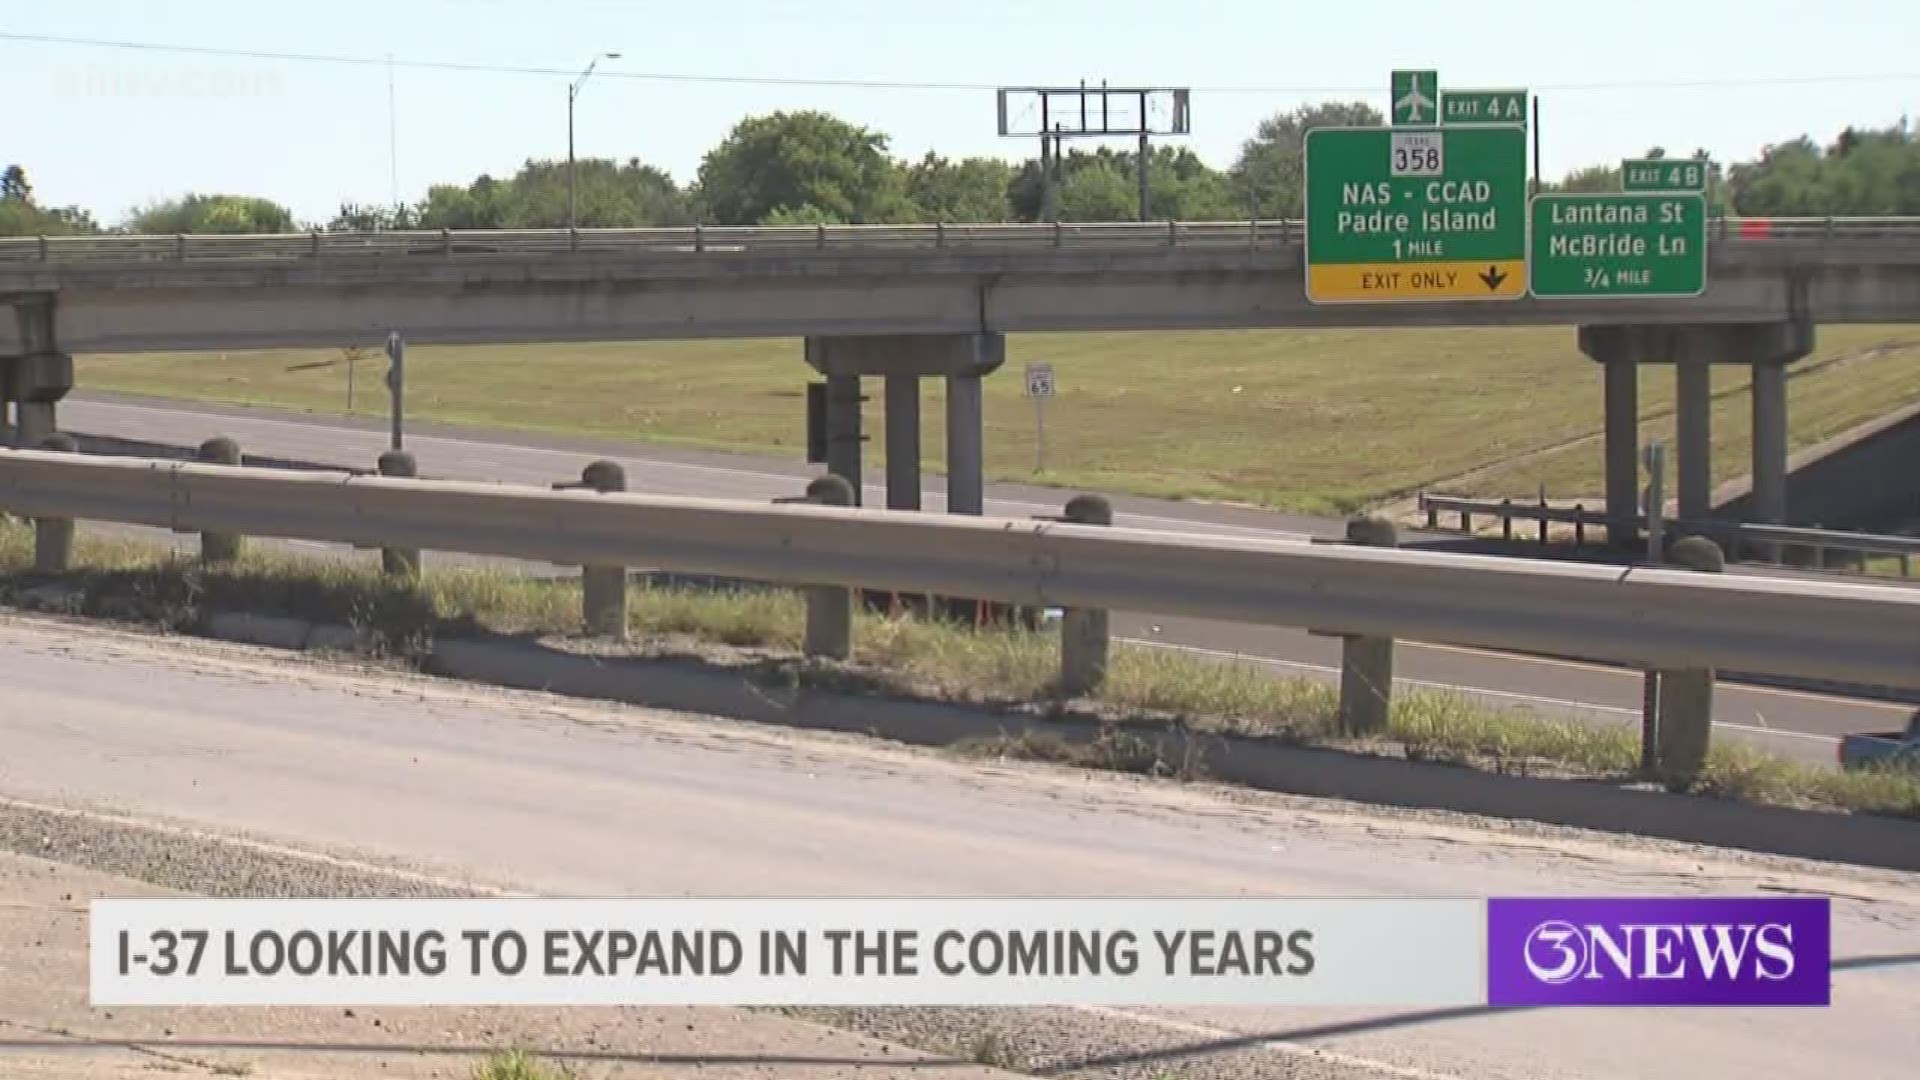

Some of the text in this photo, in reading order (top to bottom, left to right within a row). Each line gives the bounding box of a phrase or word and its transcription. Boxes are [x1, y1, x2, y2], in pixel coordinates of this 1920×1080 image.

[1448, 97, 1479, 115] EXIT
[1395, 148, 1439, 171] 358
[1630, 168, 1659, 183] EXIT
[1343, 182, 1391, 205] NAS
[1426, 181, 1490, 203] CCAD
[1338, 206, 1496, 234] Padre Island
[1552, 202, 1684, 224] Lantana St
[1393, 239, 1443, 259] 1 MILE
[1550, 233, 1685, 257] McBride Ln
[1362, 272, 1458, 289] EXIT ONLY
[1616, 270, 1652, 284] MILE
[1031, 380, 1049, 395] 65
